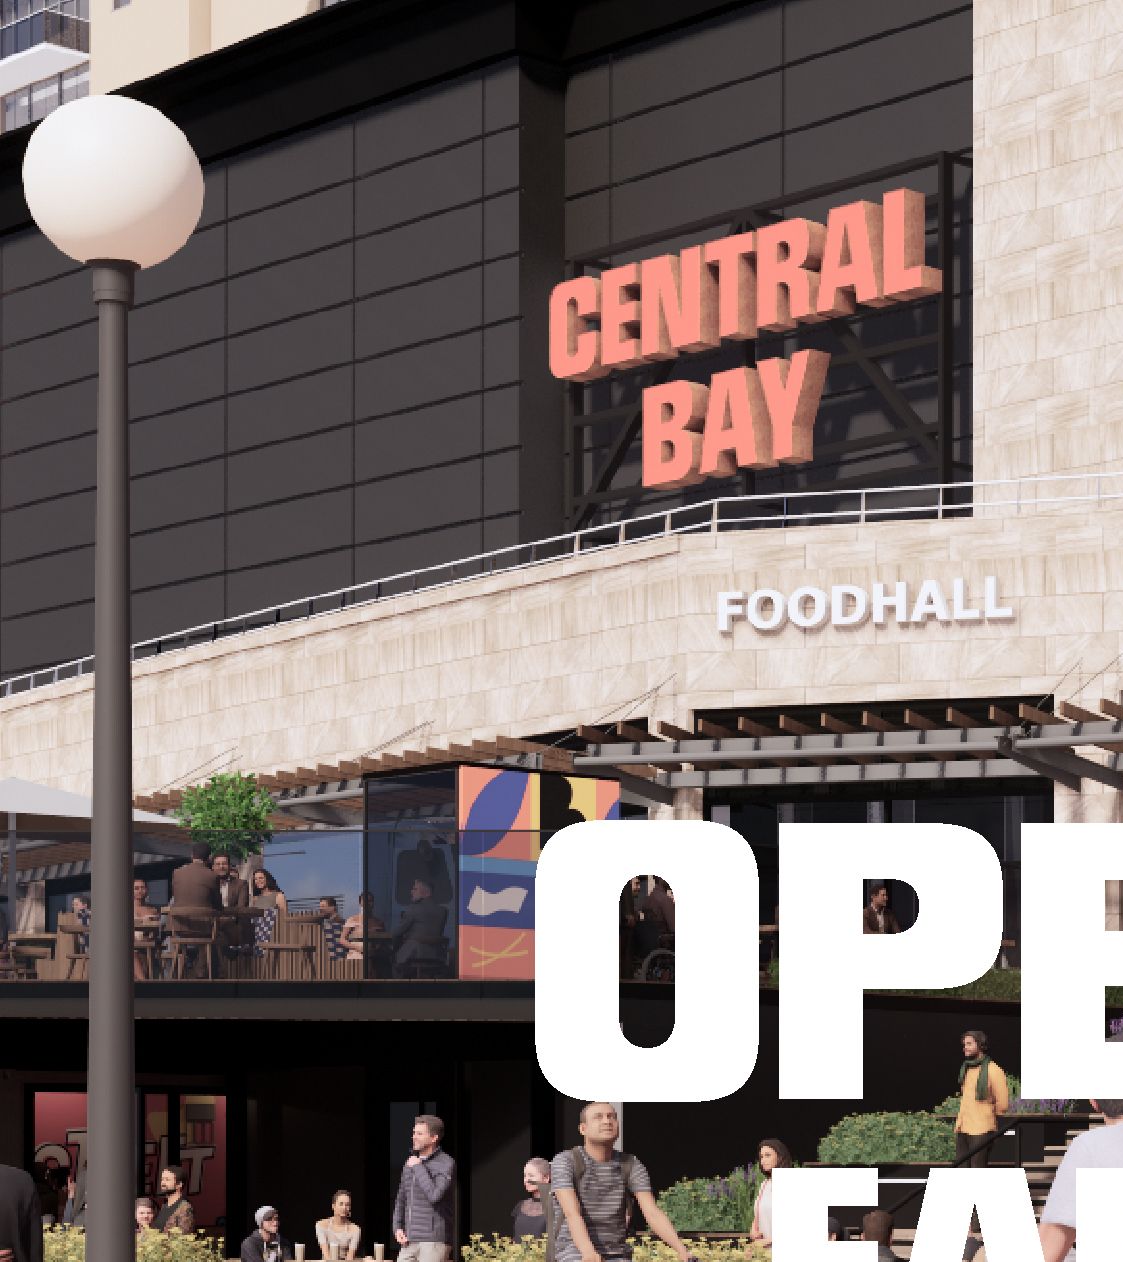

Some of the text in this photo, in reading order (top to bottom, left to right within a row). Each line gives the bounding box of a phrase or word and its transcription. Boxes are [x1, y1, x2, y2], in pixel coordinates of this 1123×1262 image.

[549, 188, 942, 382] CENTRAL
[642, 349, 831, 489] BAY
[716, 575, 1015, 634] FOODHALL
